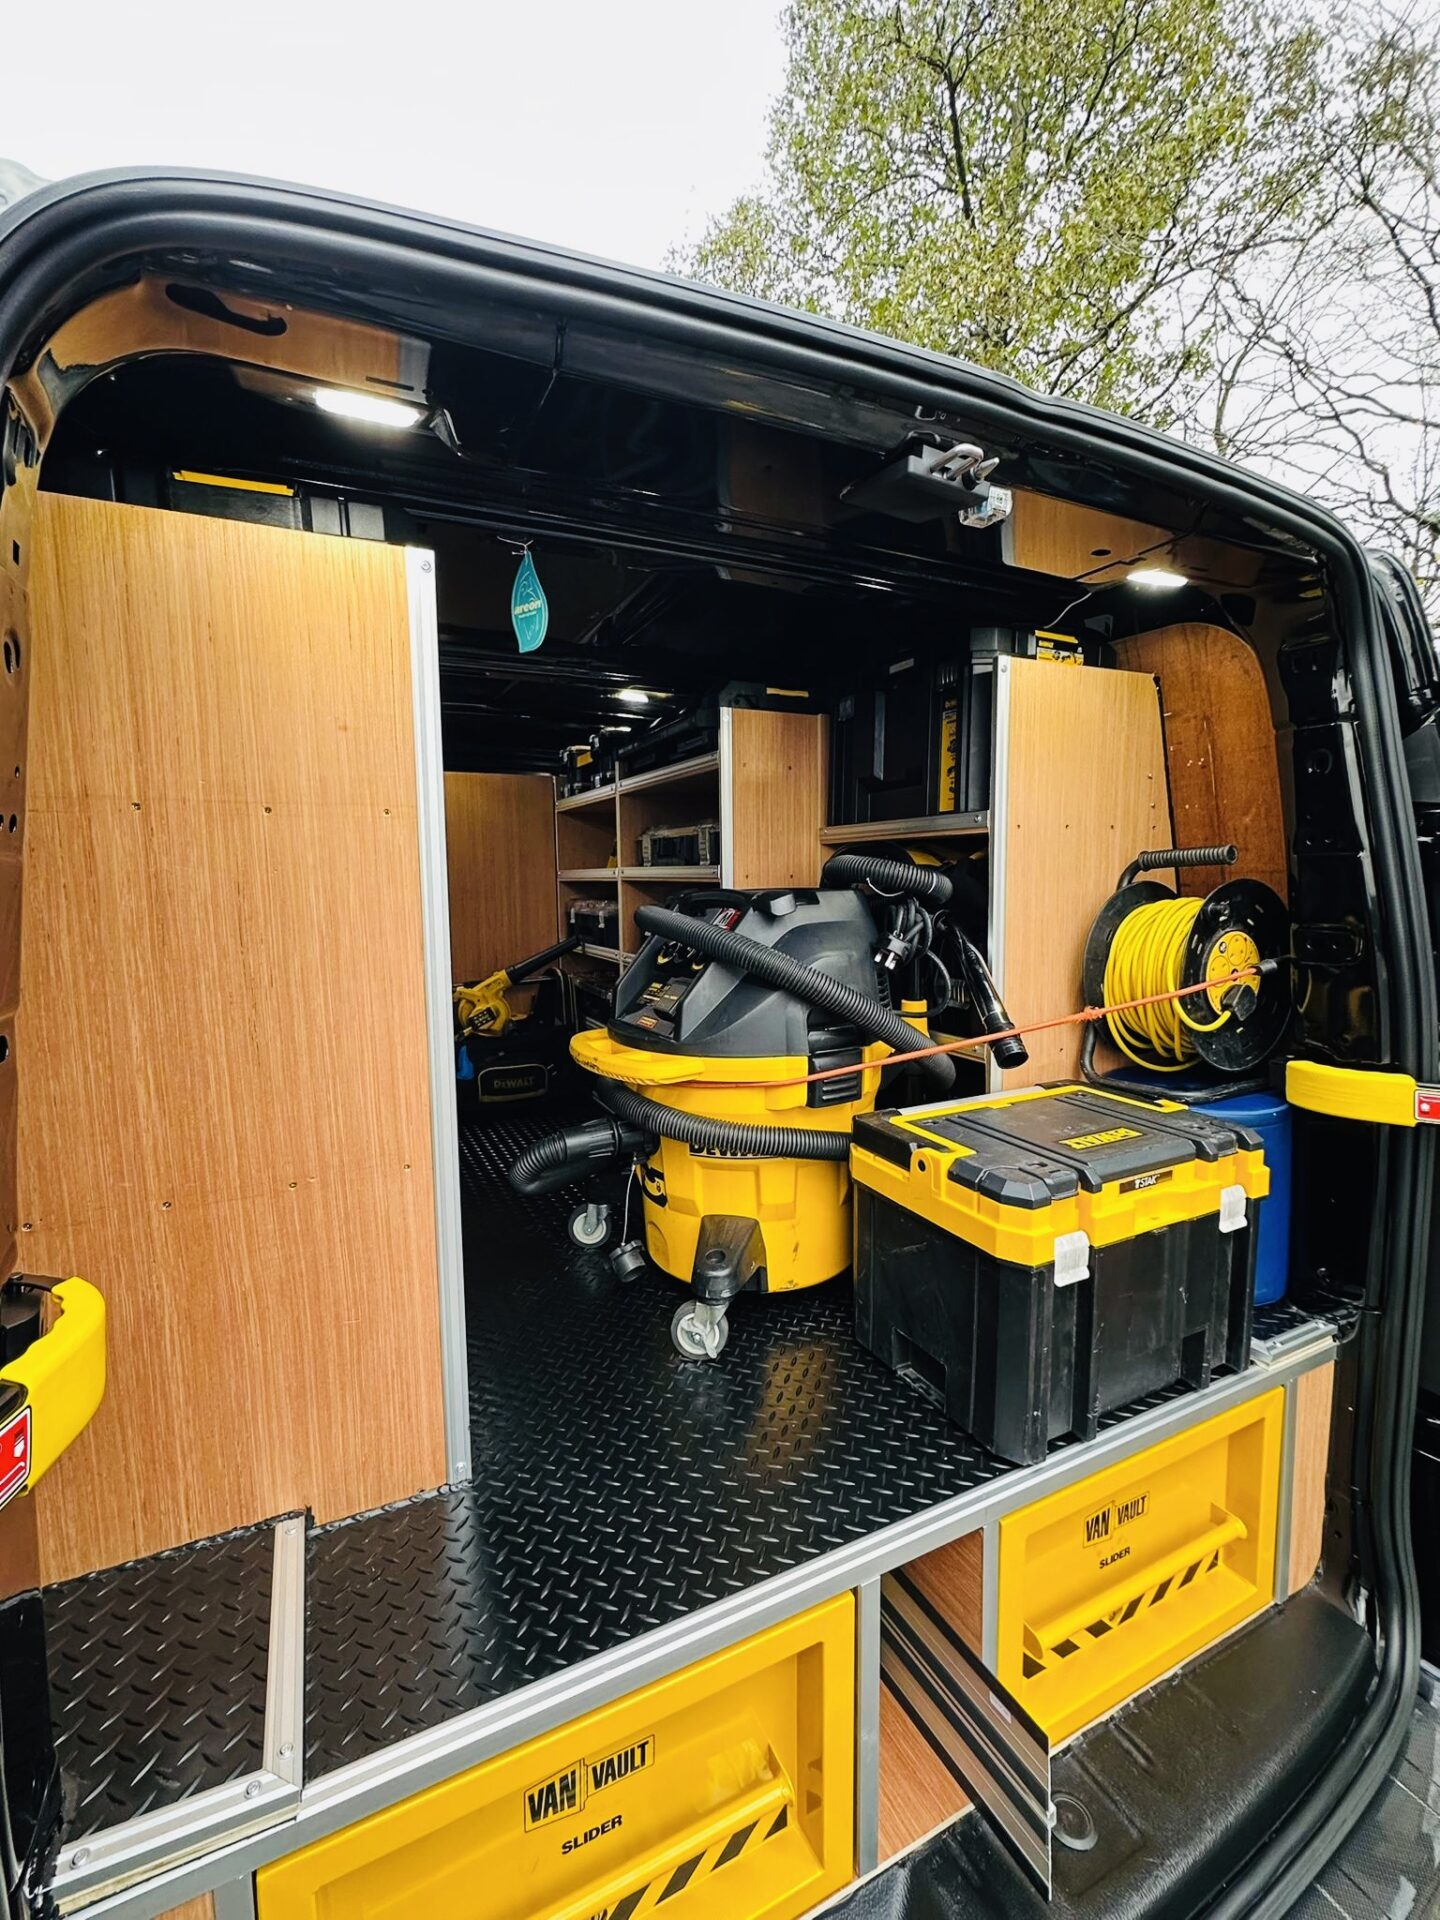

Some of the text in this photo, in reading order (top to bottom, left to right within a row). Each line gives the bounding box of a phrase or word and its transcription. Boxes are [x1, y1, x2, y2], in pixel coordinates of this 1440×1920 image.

[1085, 1494, 1148, 1543] VAN VAULT
[1098, 1545, 1131, 1570] SLIDER
[527, 1739, 650, 1824] VAN VAULT
[561, 1813, 623, 1856] SLIDER
